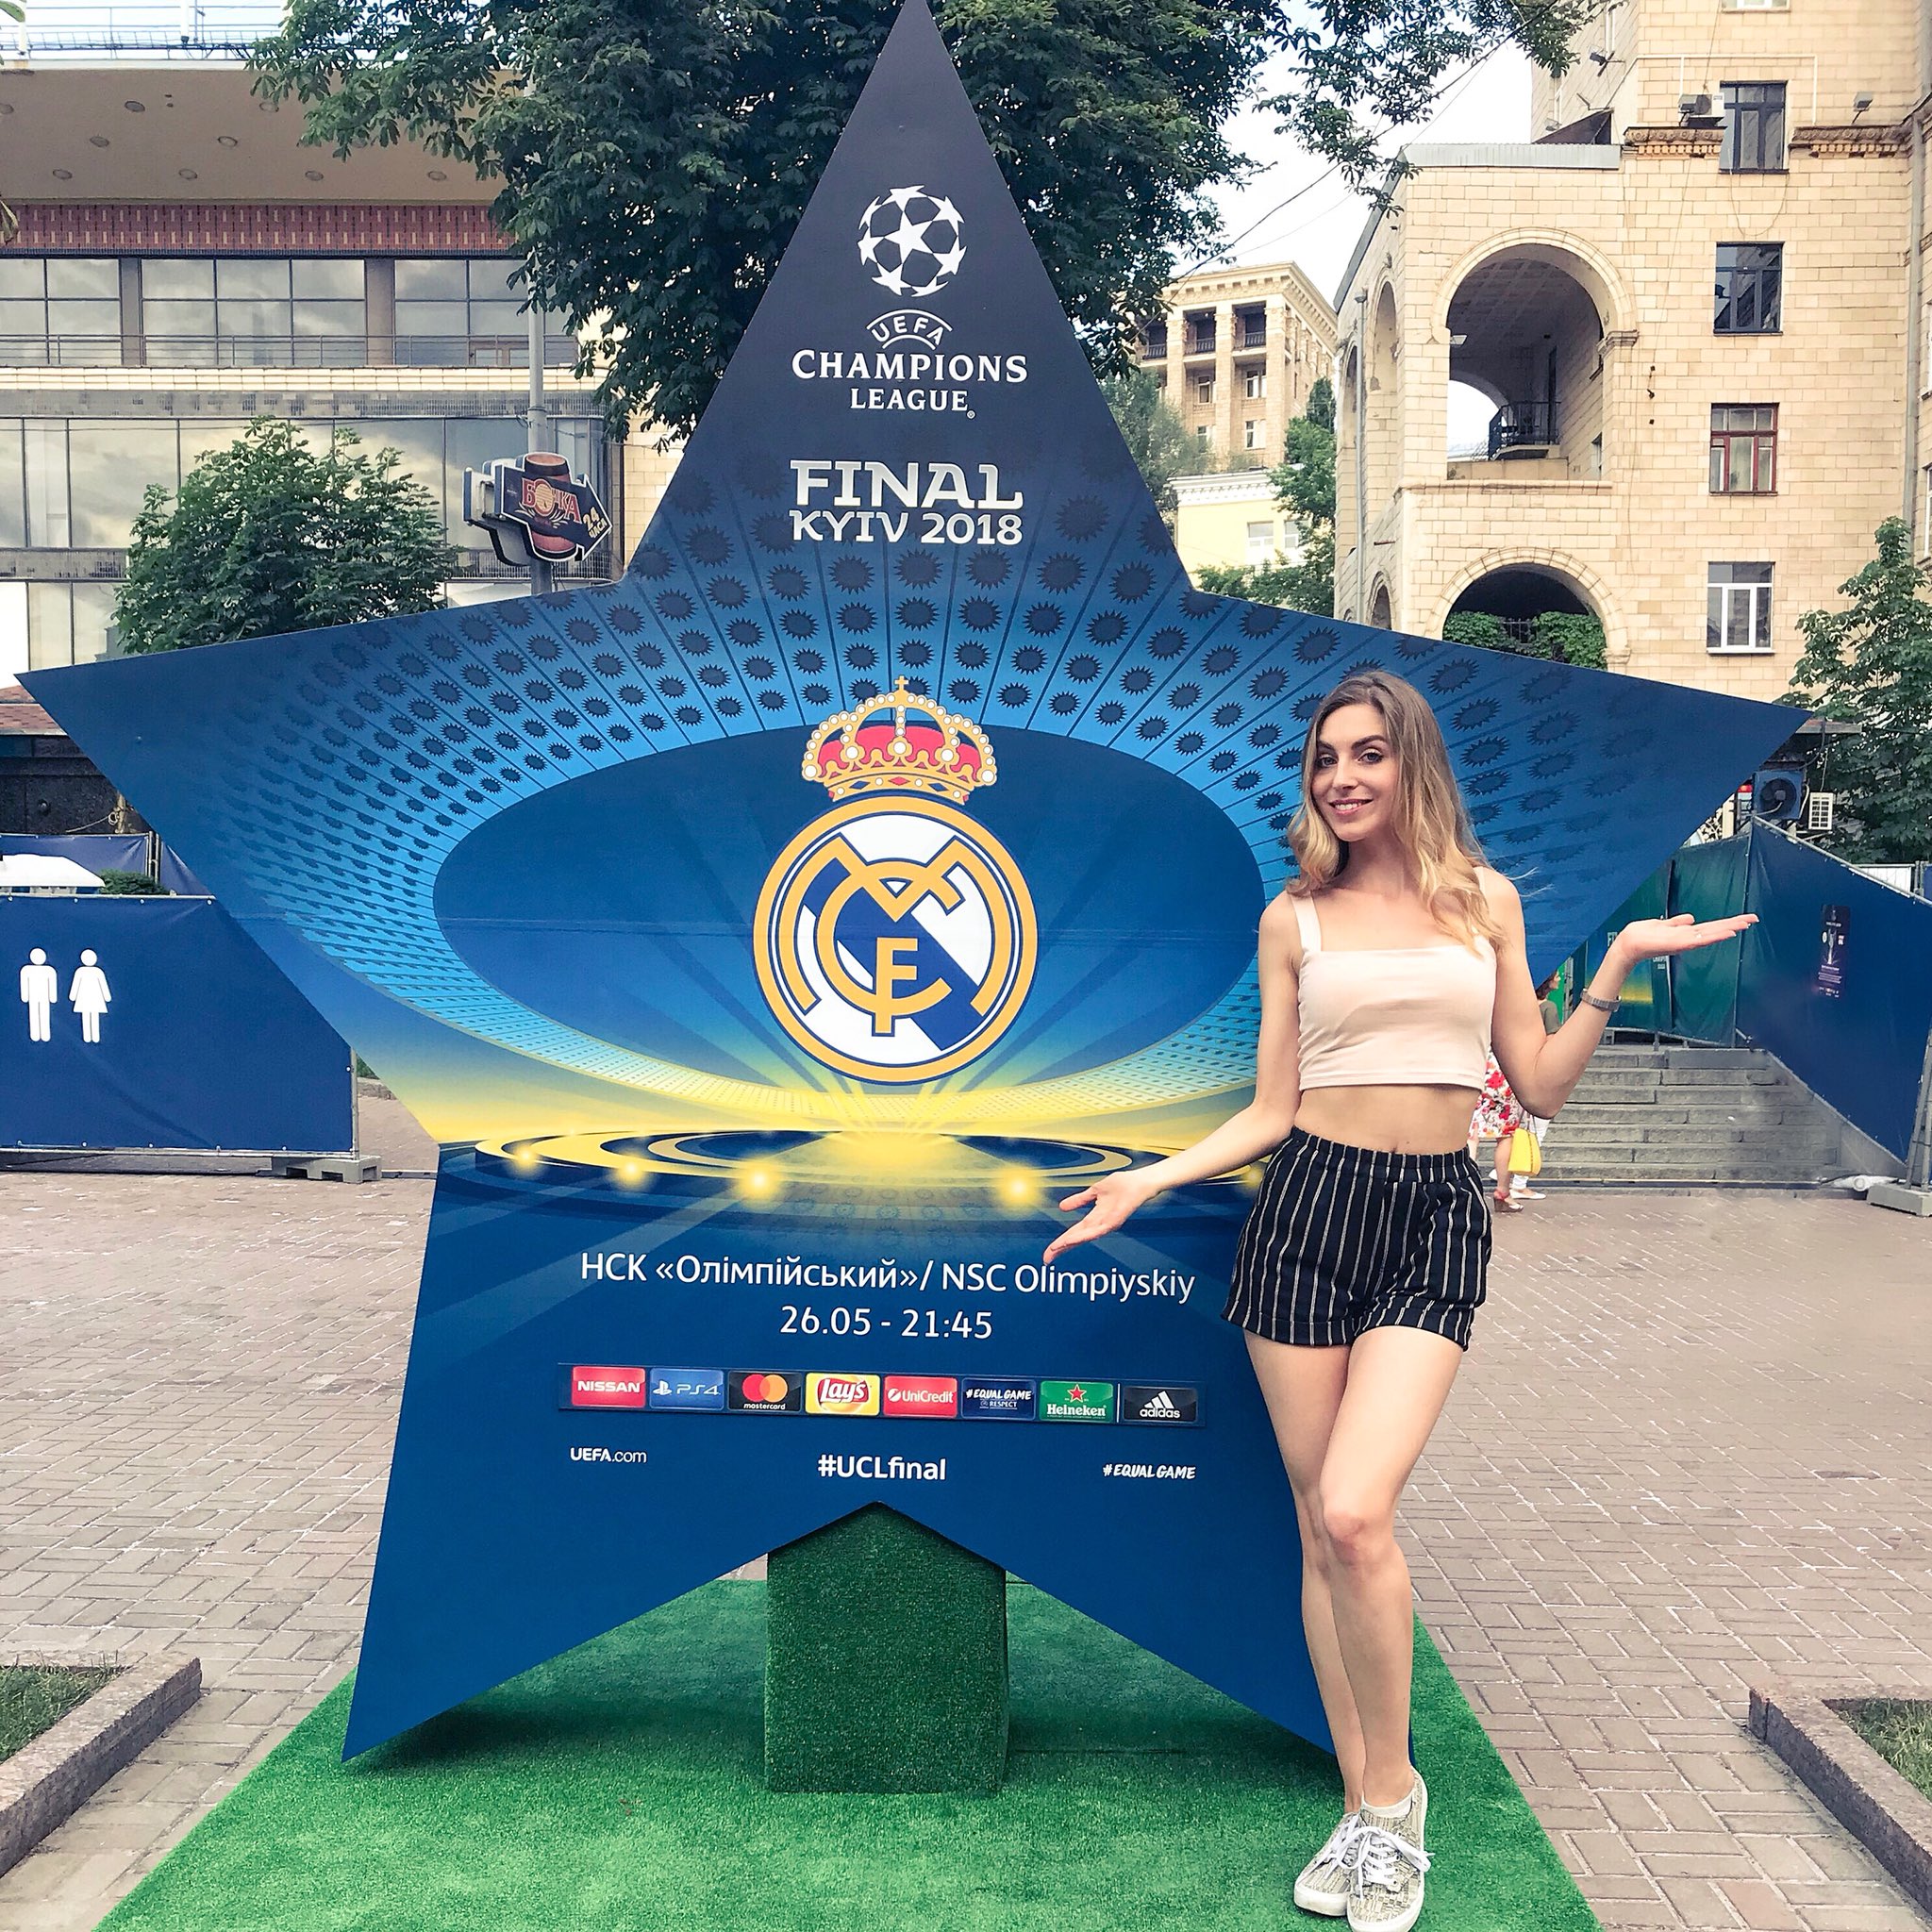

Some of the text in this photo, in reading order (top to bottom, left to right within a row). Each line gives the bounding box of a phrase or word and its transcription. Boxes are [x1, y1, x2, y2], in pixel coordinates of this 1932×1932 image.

[870, 314, 943, 344] UEFA
[791, 349, 1028, 383] CHAMPIONS
[850, 388, 970, 412] LEAGUE
[790, 459, 1024, 509] FINAL
[522, 477, 582, 524] БОЧКА
[583, 507, 600, 530] 24
[789, 509, 1024, 545] KYIV 2018
[581, 1253, 647, 1281] НСК
[942, 1262, 1007, 1291] NSC
[1014, 1264, 1195, 1304] Olimpiyskiy
[780, 1306, 871, 1336] 26.05
[901, 1308, 992, 1339] 21:45
[576, 1380, 641, 1393] NISSAN
[676, 1384, 720, 1396] PS4
[902, 1389, 954, 1404] UniCredit
[743, 1402, 786, 1411] mastercard
[1047, 1404, 1106, 1417] Heineken
[1140, 1407, 1180, 1419] adidas
[570, 1447, 648, 1463] UEFA.com
[818, 1454, 947, 1480] #UCLfinal
